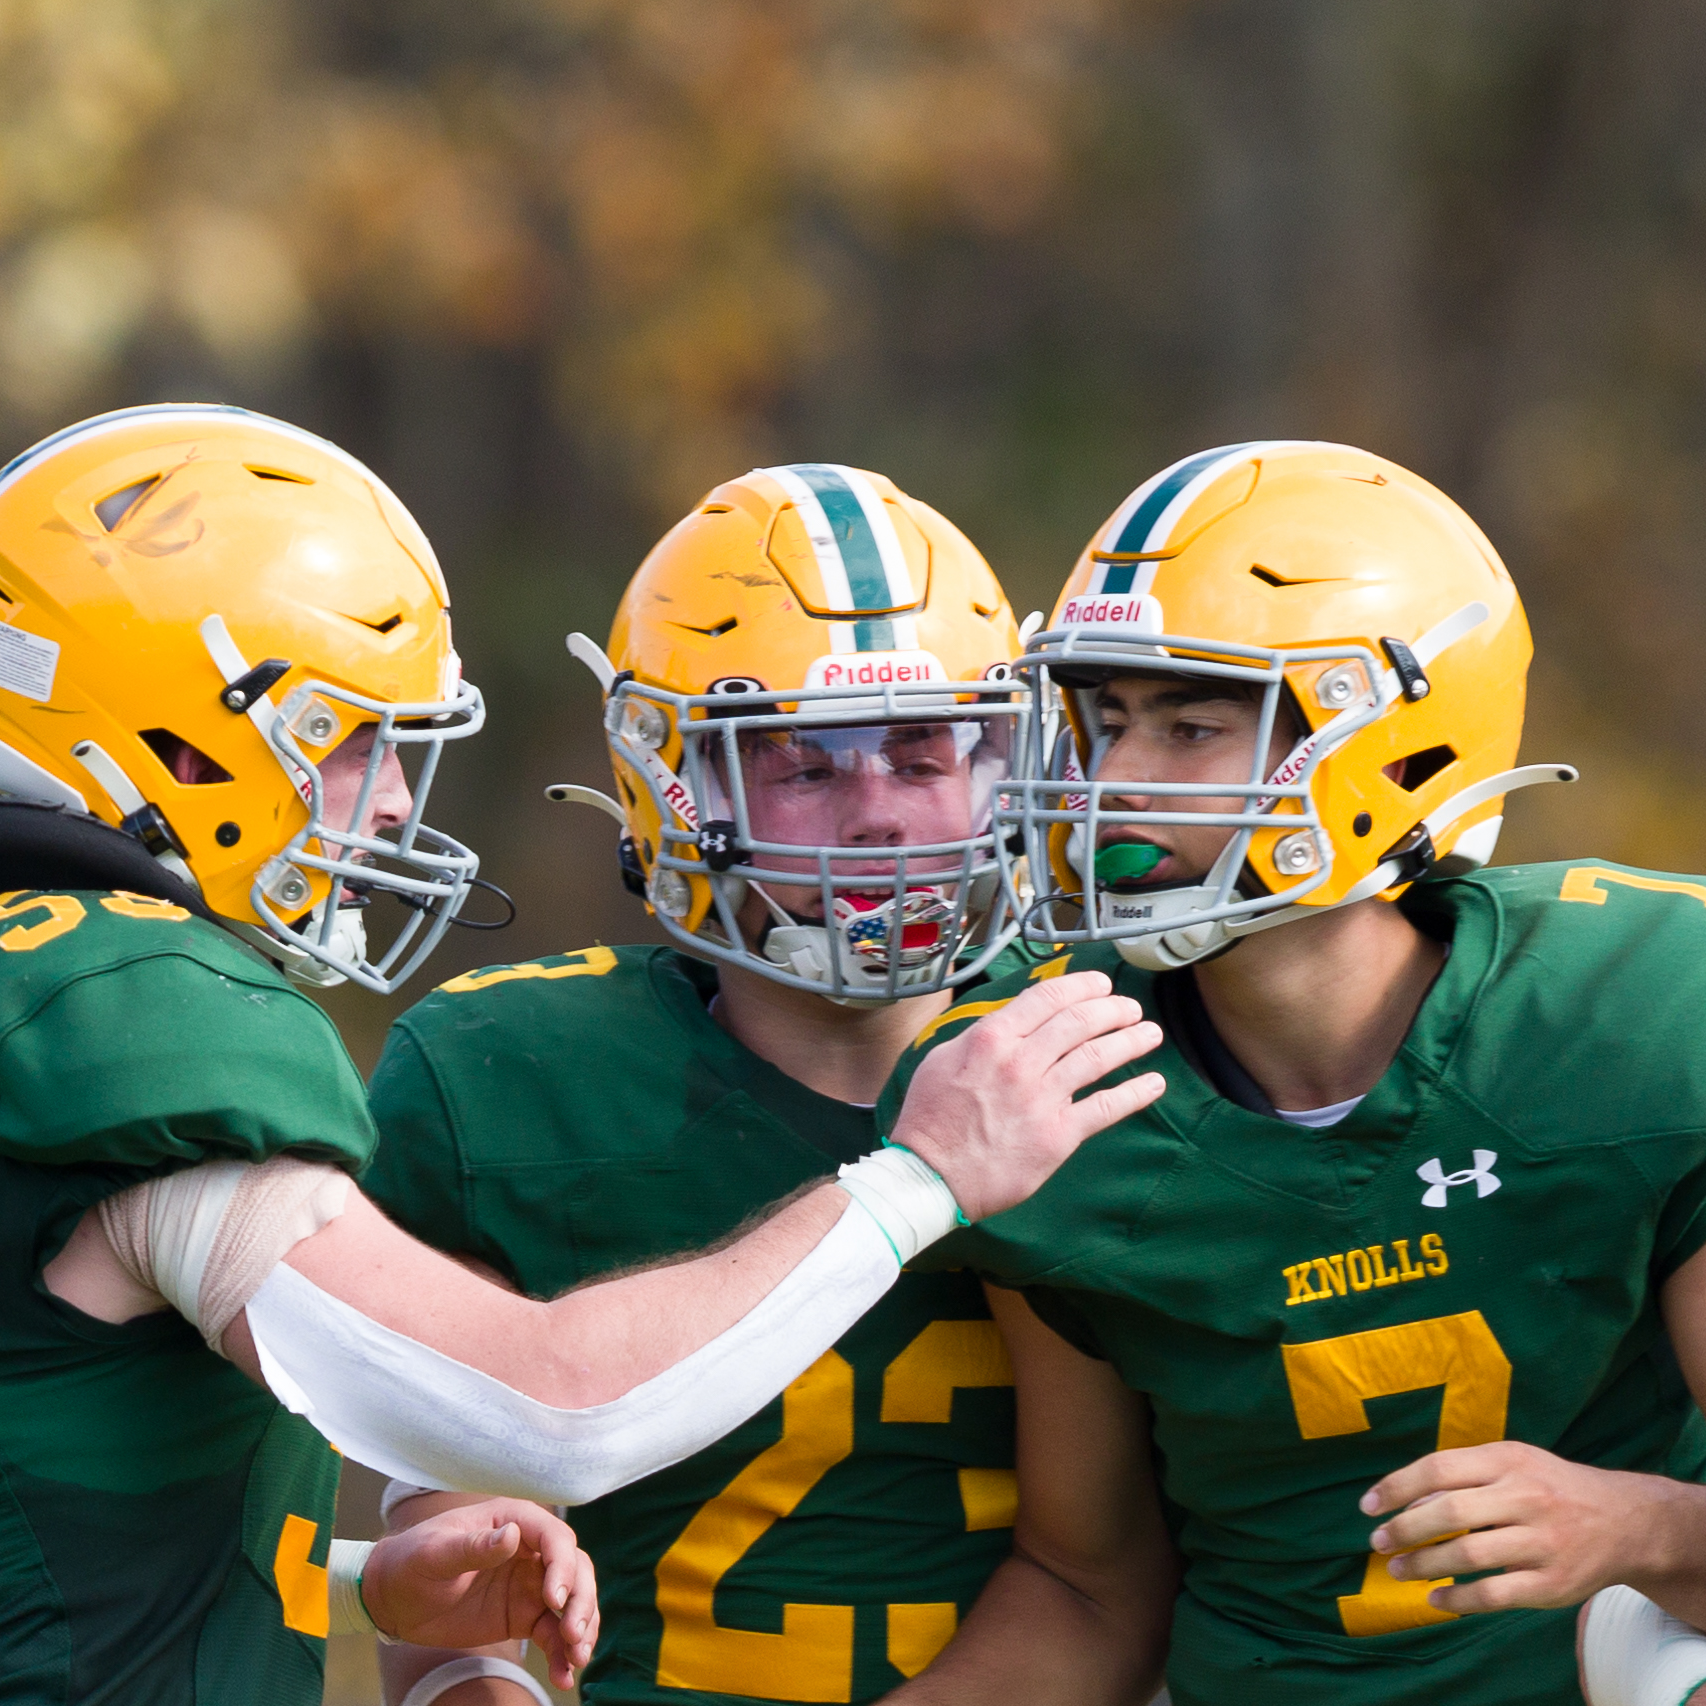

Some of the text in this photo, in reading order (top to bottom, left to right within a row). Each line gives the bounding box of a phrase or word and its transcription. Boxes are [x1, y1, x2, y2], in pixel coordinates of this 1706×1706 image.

[1065, 600, 1142, 624] Riddell
[824, 661, 930, 686] Riddell
[1282, 1232, 1449, 1306] KNOLLS
[1281, 1310, 1513, 1638] 7
